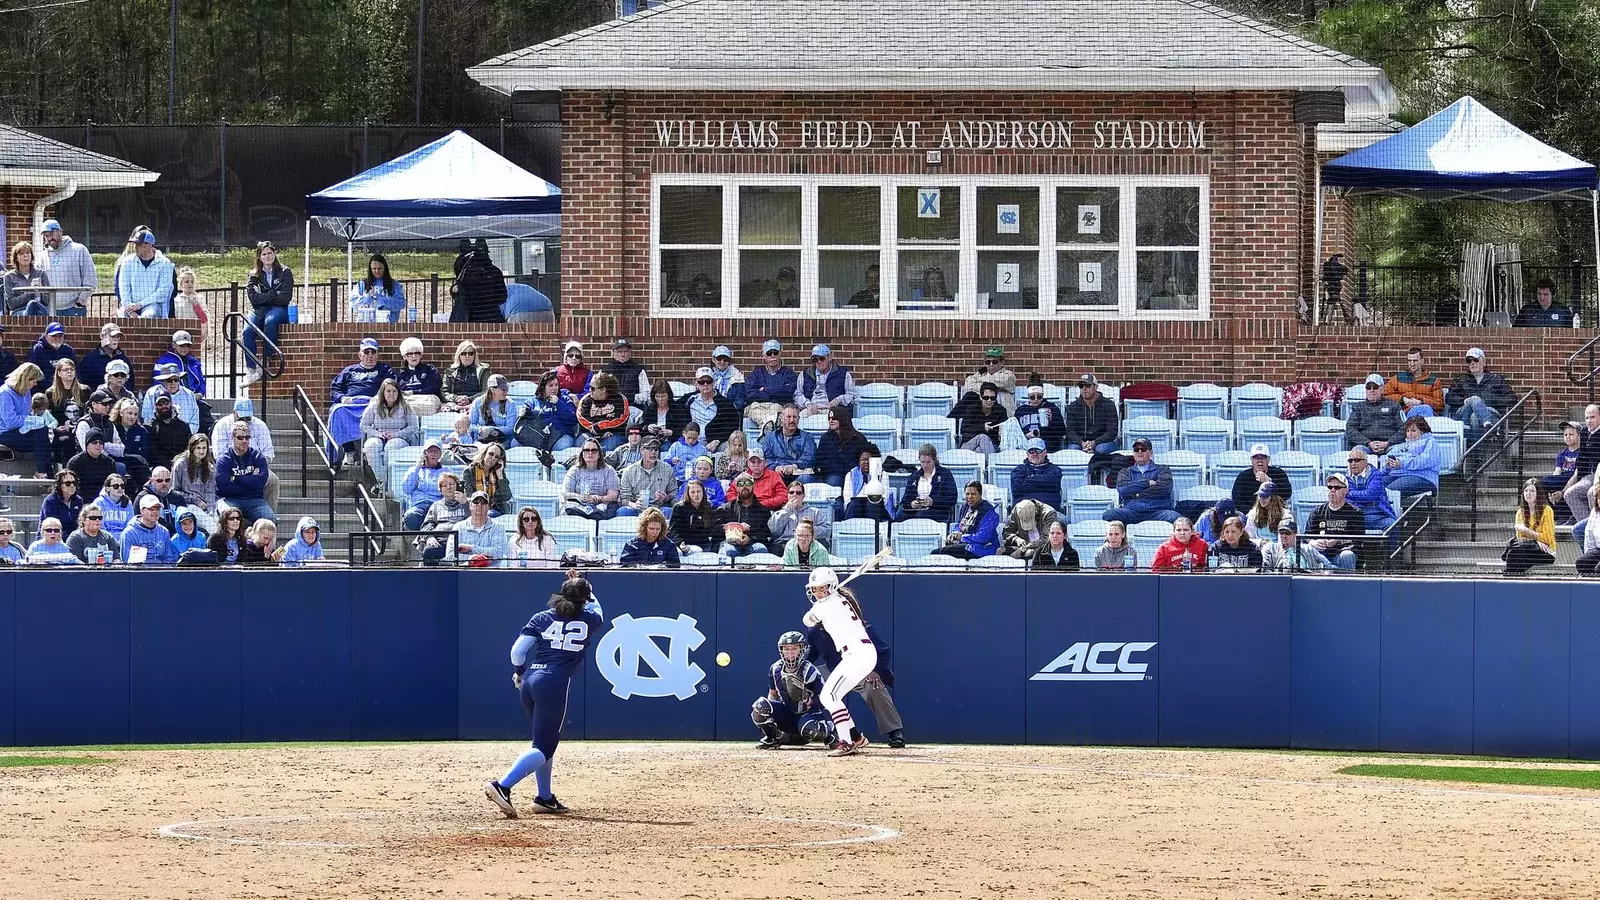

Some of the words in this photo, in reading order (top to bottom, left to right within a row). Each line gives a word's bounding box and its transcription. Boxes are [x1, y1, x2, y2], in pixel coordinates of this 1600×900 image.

[654, 119, 779, 148] WILLIAMS
[799, 120, 873, 148] FIELD
[891, 121, 920, 148] AT
[940, 121, 1073, 148] ANDERSON
[1094, 121, 1206, 148] STADIUM
[920, 192, 938, 215] X
[1004, 271, 1012, 284] 2
[1086, 271, 1094, 284] 0
[540, 620, 589, 652] 42
[1038, 641, 1158, 673] ACC
